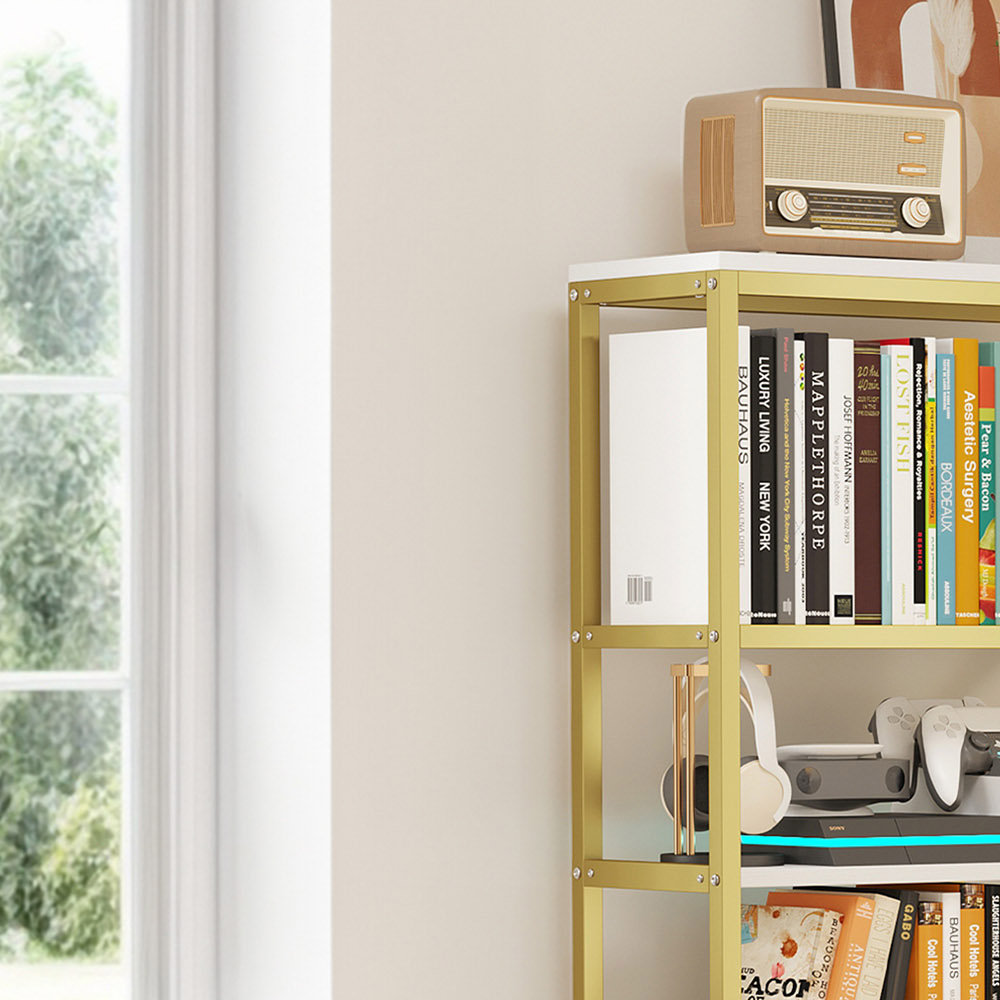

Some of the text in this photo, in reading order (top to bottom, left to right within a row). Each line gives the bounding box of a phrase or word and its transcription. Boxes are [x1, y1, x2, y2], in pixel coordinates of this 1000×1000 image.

[857, 366, 868, 377] 20
[739, 366, 748, 464] BAUHAUS
[844, 395, 852, 483] JOSEF HOFFMANN
[896, 354, 910, 472] LOST FISH
[759, 357, 770, 551] LUXURY LIVING NEW YORK
[812, 371, 825, 550] MAPPLETHORPE
[962, 391, 976, 523] Aestetic Surgery
[981, 424, 992, 511] Pear & Bacon
[941, 462, 952, 532] BORDEAUX
[821, 918, 839, 972] BEACON
[901, 904, 914, 940] GABO
[928, 939, 938, 958] Cool
[949, 917, 959, 979] BAUHAUS
[969, 924, 980, 945] Cool
[992, 895, 1000, 987] SLAUGHTERHOUSE ANGELS
[928, 960, 938, 988] Hotels
[969, 947, 980, 977] Hotels
